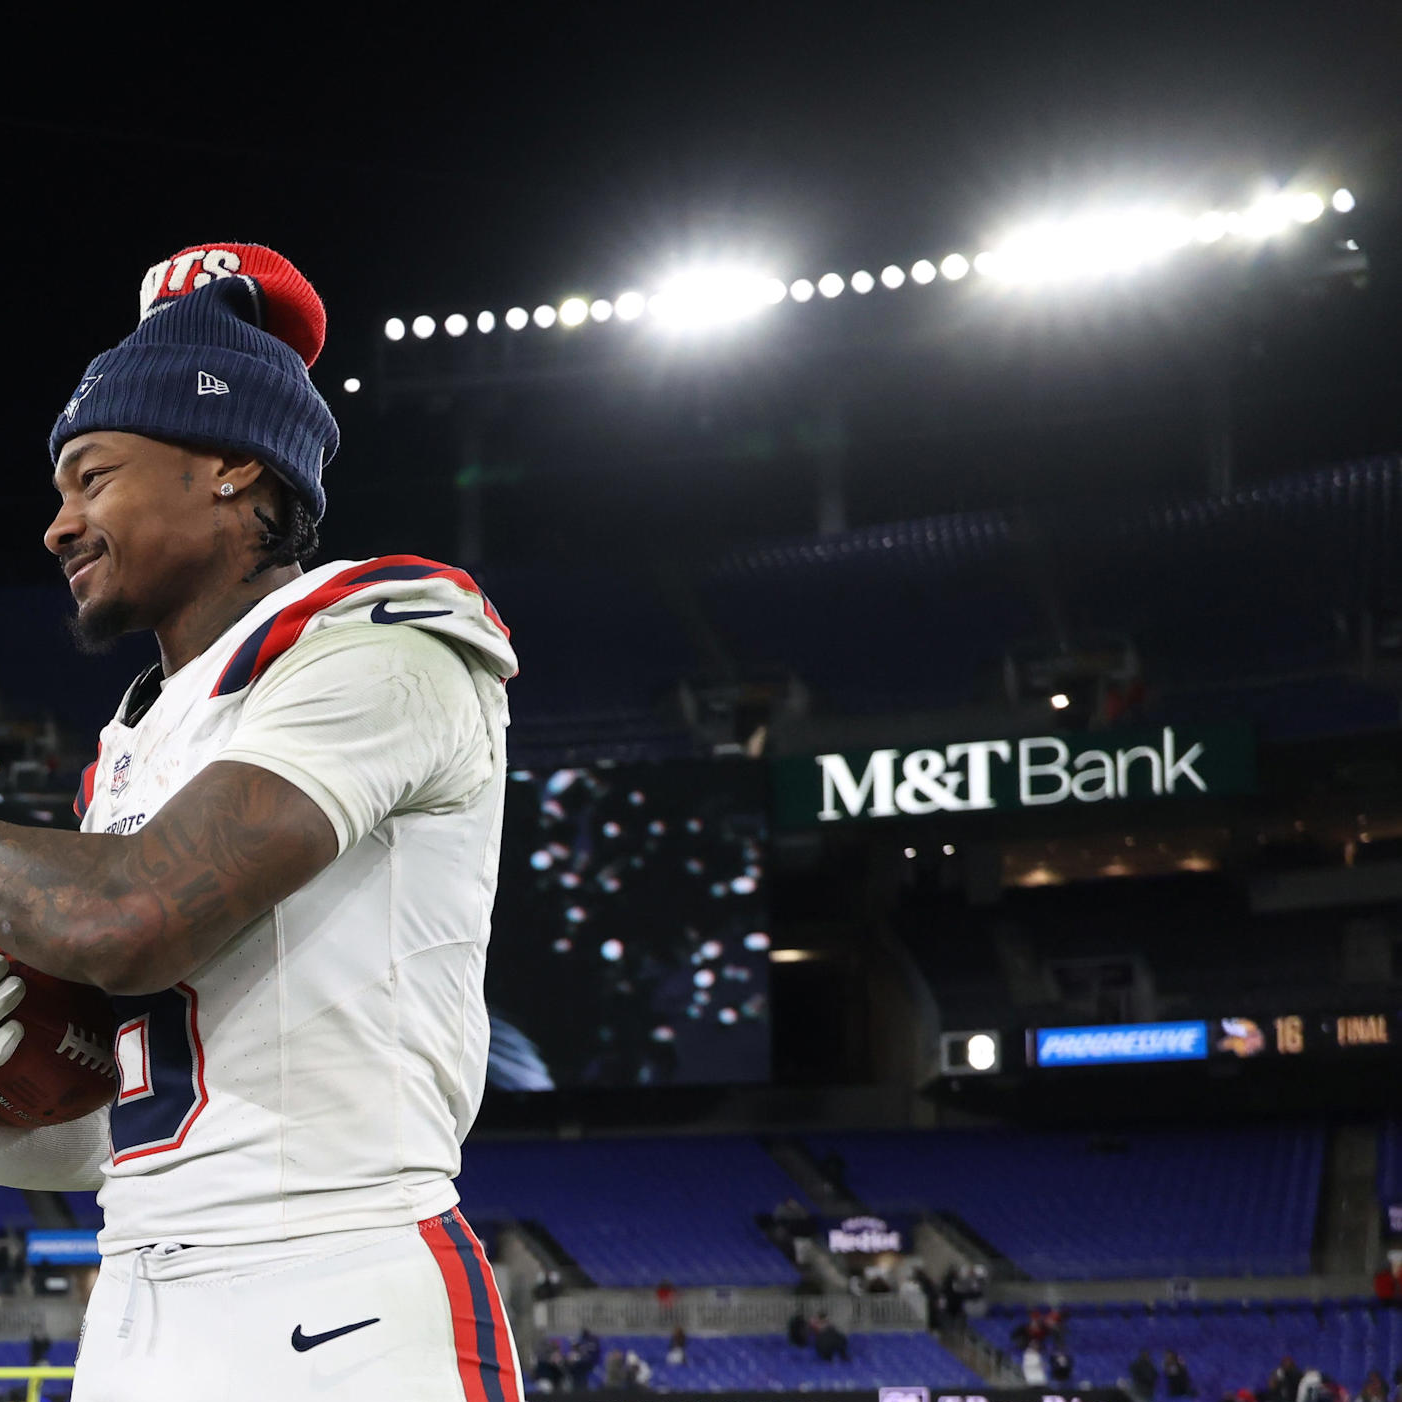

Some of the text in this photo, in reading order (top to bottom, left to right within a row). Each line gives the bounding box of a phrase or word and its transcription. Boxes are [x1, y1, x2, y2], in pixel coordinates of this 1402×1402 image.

[815, 726, 1208, 821] M&T Bank
[1040, 1026, 1200, 1060] PROGRESSIVE
[1336, 1014, 1389, 1046] FINAL
